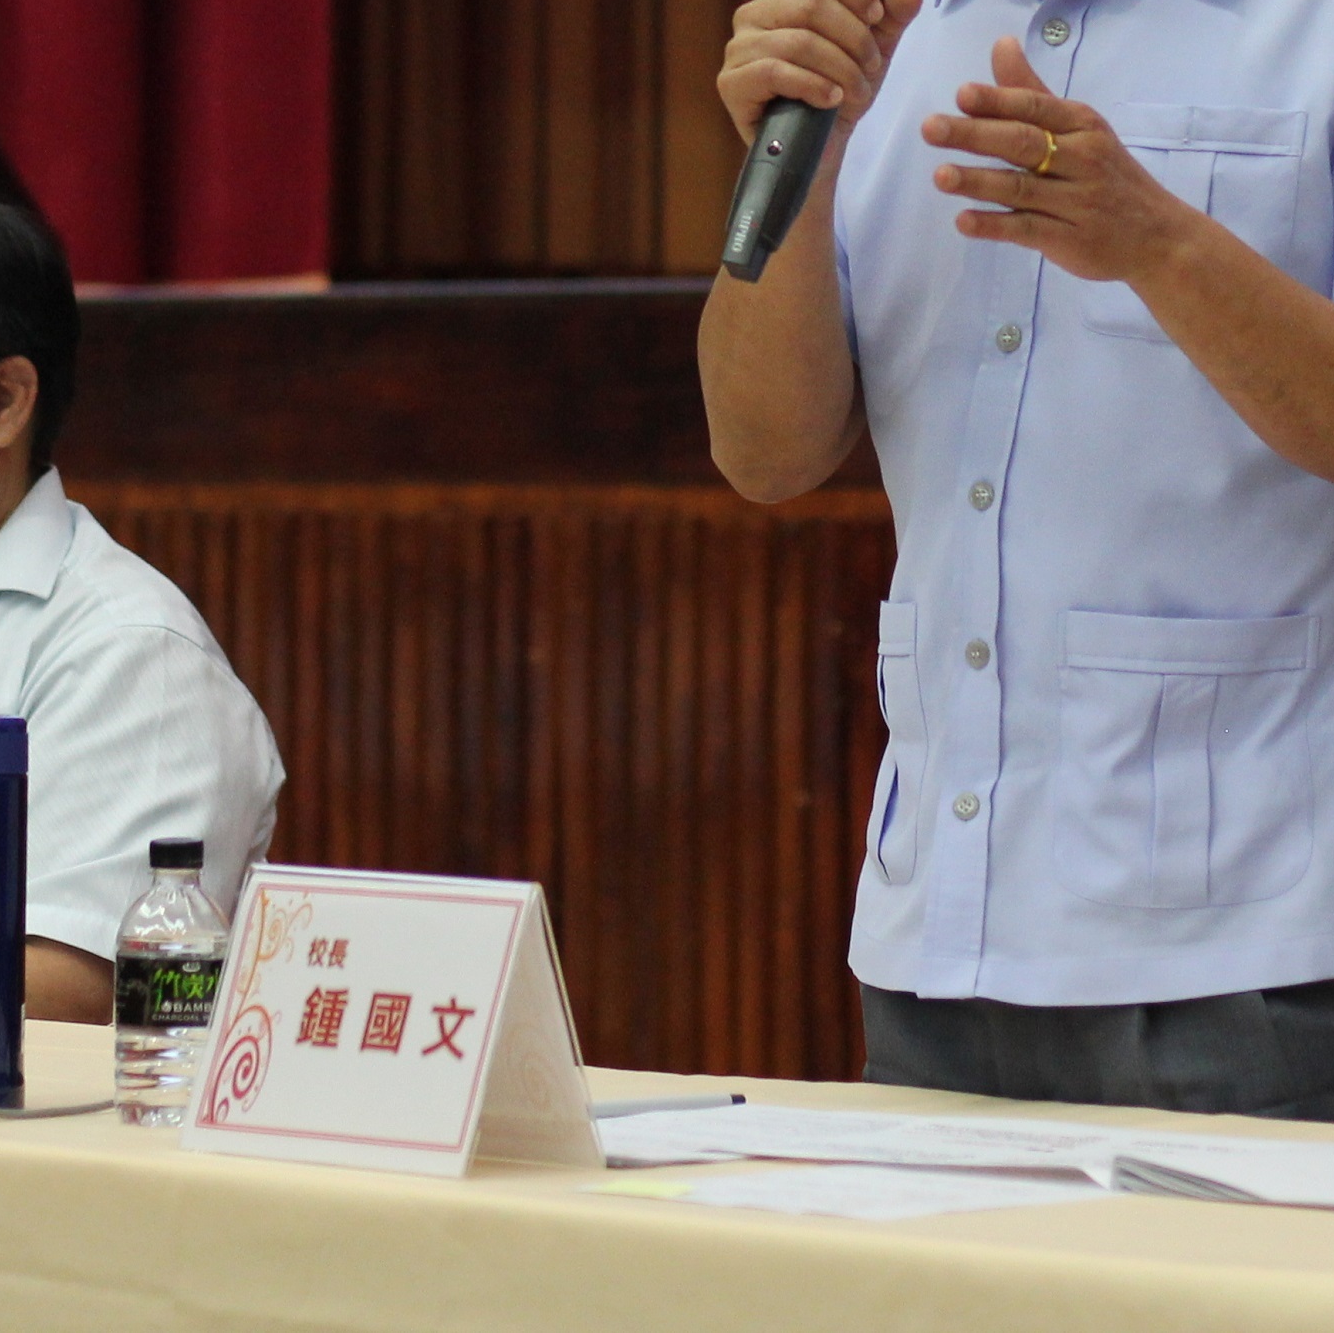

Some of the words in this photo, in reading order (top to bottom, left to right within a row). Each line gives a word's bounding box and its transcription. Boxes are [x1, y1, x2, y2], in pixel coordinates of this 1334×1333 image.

[307, 938, 350, 969] 校長
[295, 986, 475, 1060] 鍾國文
